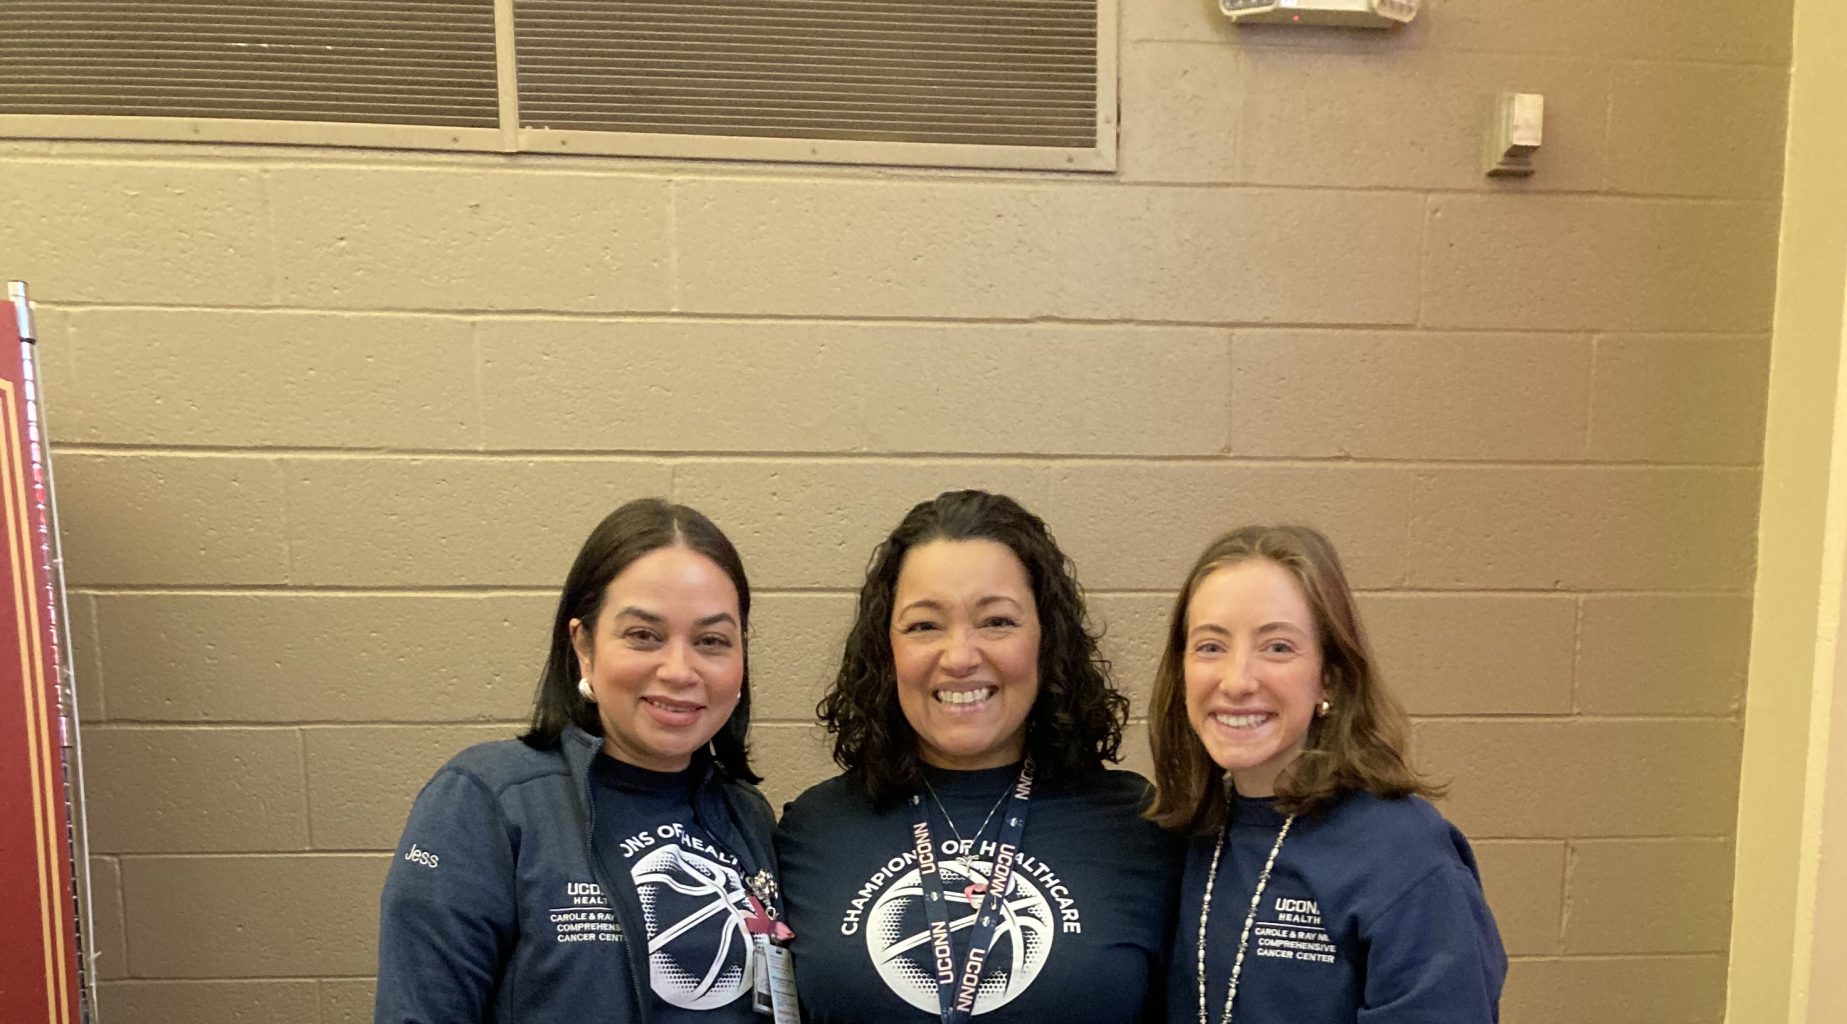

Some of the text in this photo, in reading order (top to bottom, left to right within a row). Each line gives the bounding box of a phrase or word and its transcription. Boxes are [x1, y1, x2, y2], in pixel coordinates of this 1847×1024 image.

[657, 823, 683, 838] OF
[405, 844, 438, 868] Jess
[913, 822, 936, 875] UCONN
[990, 843, 1016, 898] UCONN
[568, 883, 602, 895] UCO
[841, 839, 1081, 936] CHAMPION OF HALTHCARE
[1275, 898, 1320, 915] UCON
[550, 913, 587, 922] CAROLE
[1279, 913, 1321, 925] HEALTH
[557, 923, 621, 932] COMPREHENS
[1255, 927, 1316, 941] CAROLE & RAY
[557, 933, 623, 942] CANCER CENT
[931, 921, 954, 985] UCONN
[1259, 938, 1336, 953] COMPREHENSIVE
[1257, 948, 1335, 963] CANCER CENTER
[957, 948, 986, 1013] UCONN
